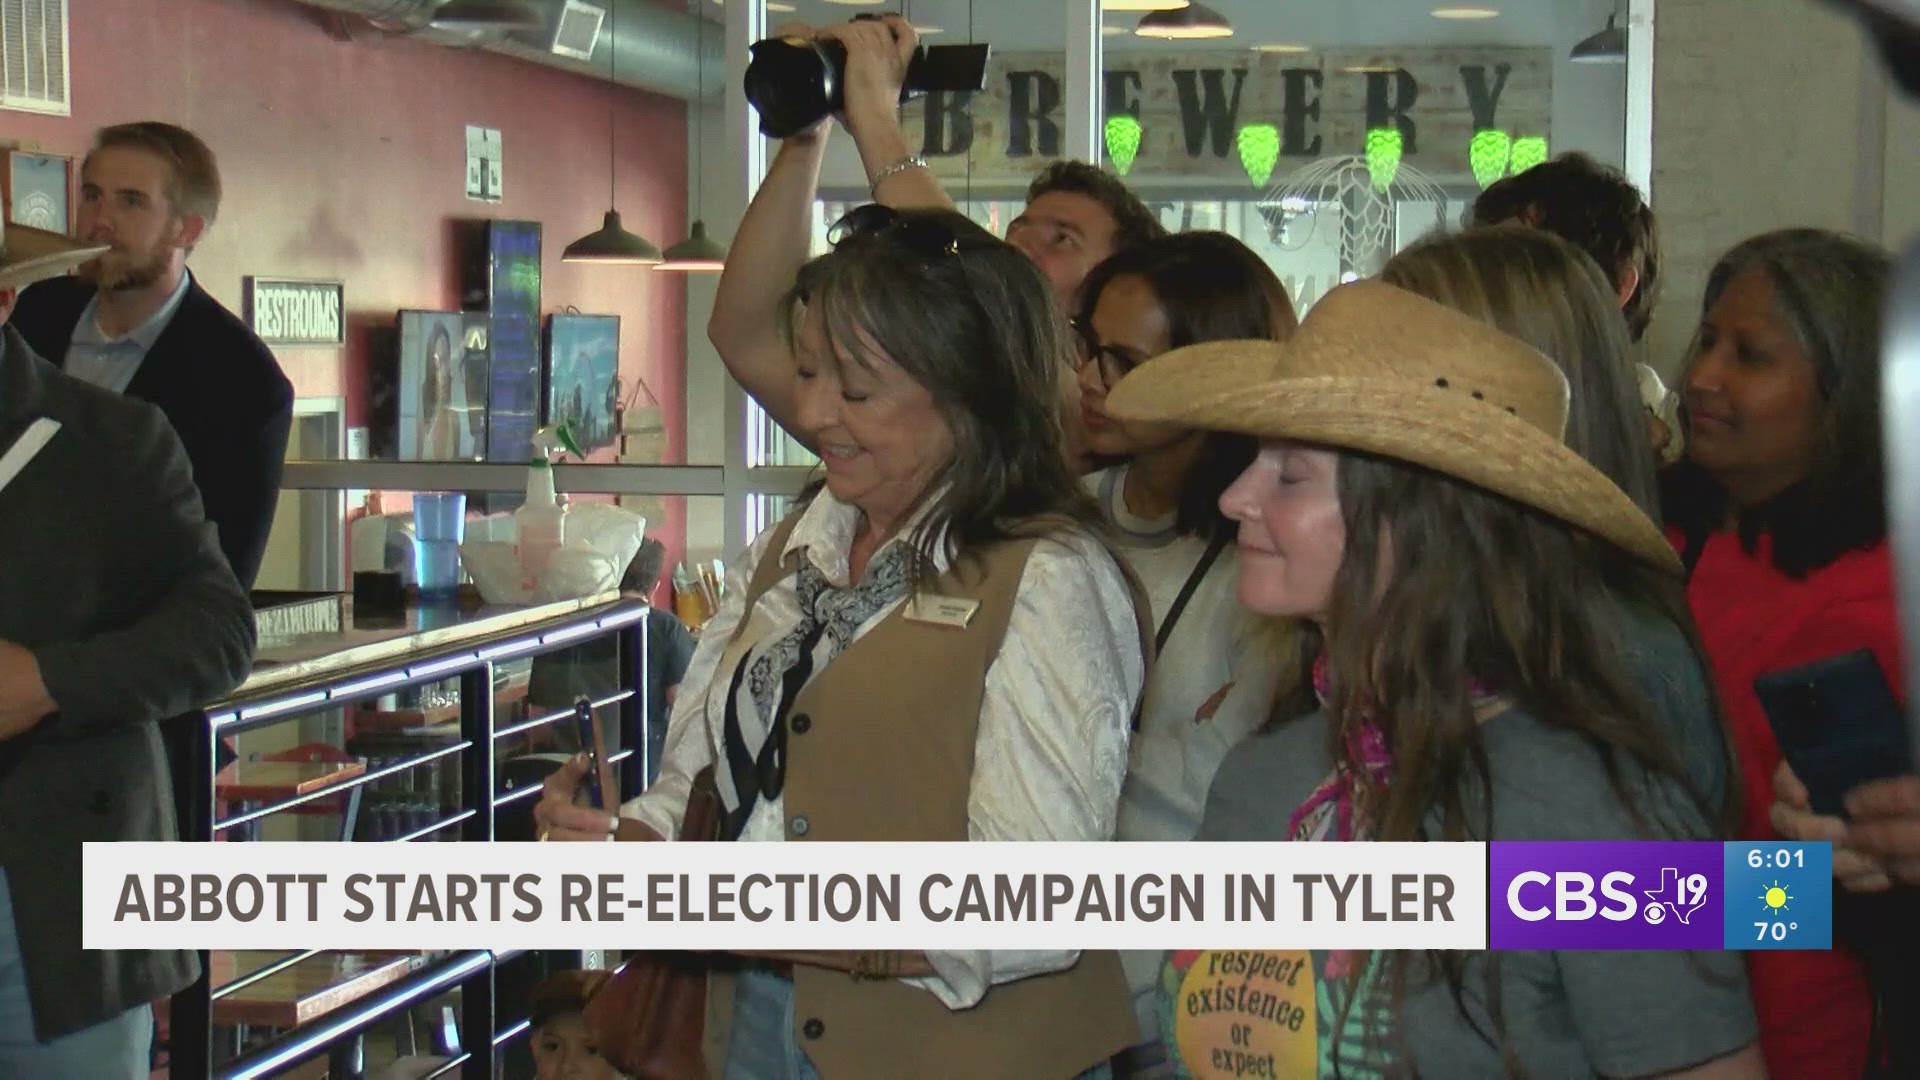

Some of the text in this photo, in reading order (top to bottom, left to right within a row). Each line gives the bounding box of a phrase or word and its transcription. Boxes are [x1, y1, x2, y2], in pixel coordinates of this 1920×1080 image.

[920, 66, 1512, 158] BREWERY
[253, 289, 339, 337] RESTROOMS
[1207, 950, 1305, 987] respect
[1187, 980, 1306, 1032] existence
[1230, 1021, 1253, 1047] or
[1211, 1046, 1277, 1080] expect
